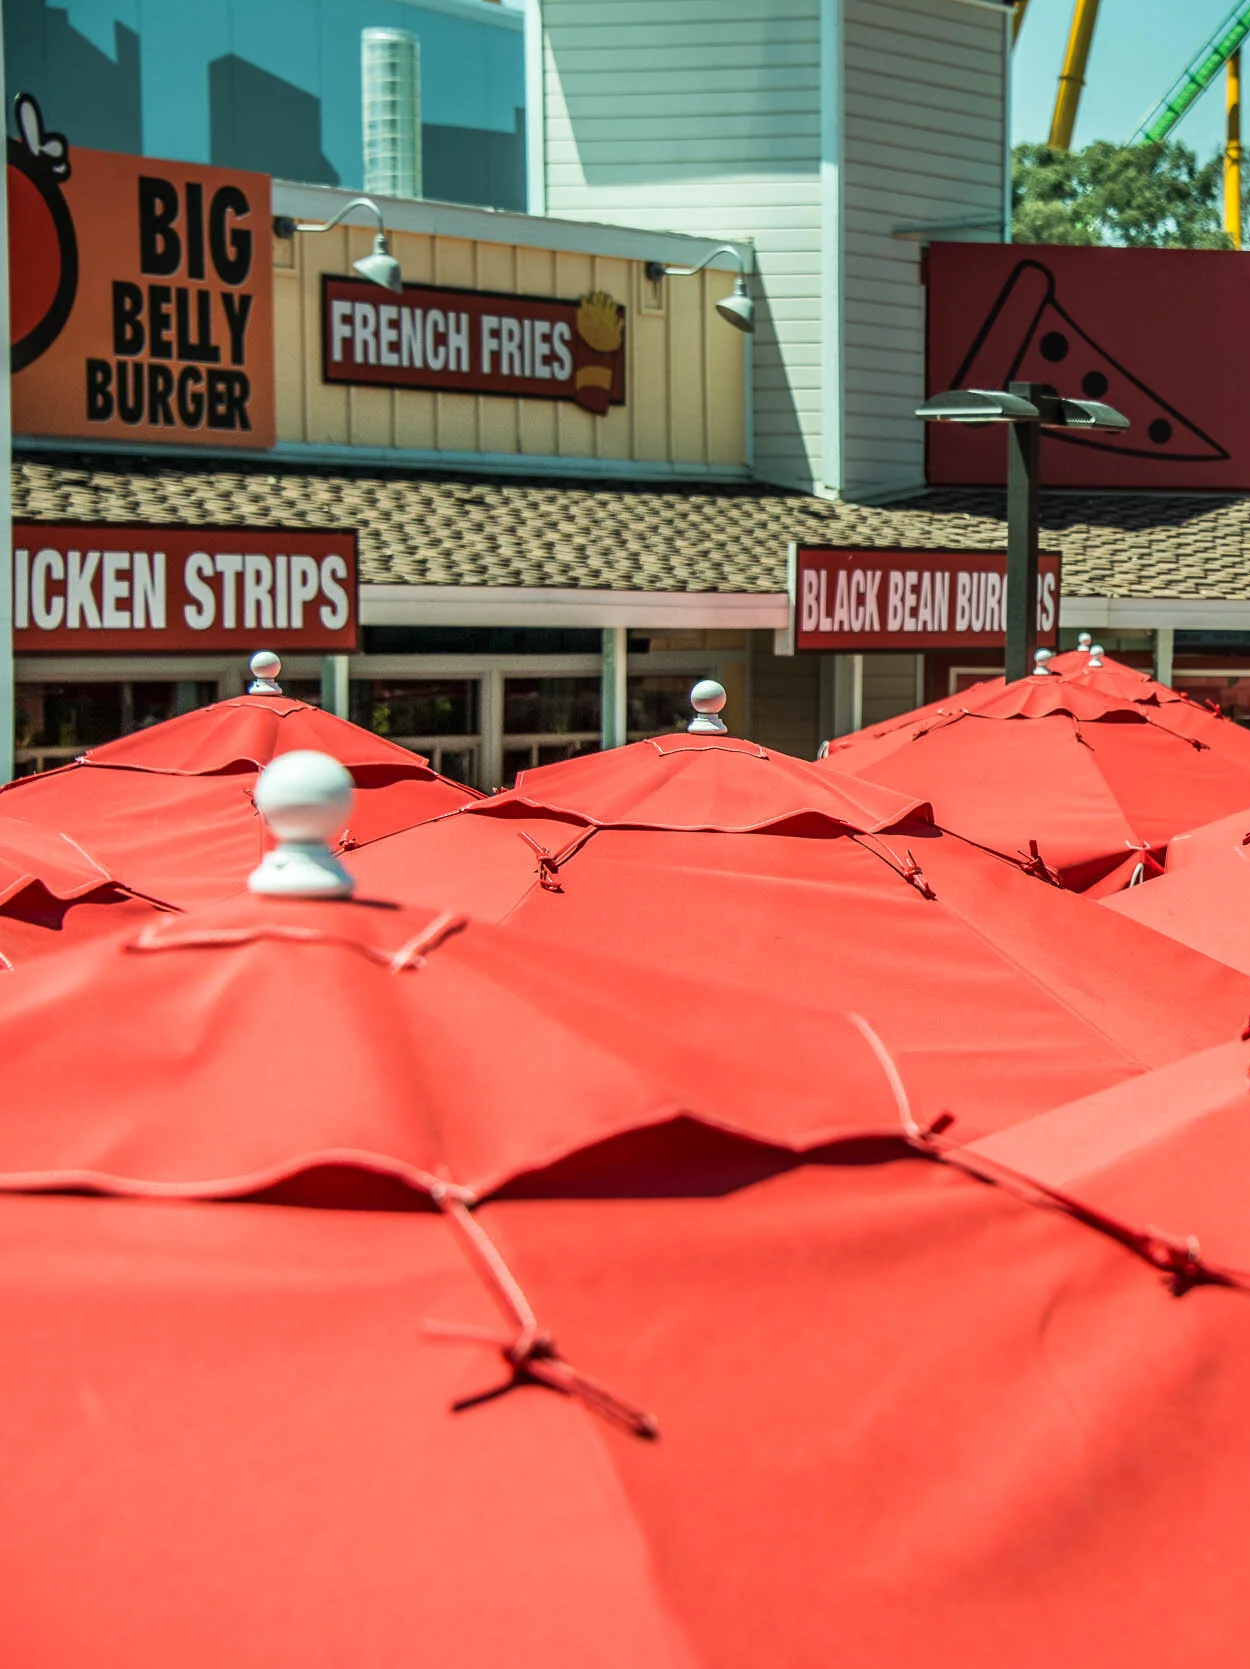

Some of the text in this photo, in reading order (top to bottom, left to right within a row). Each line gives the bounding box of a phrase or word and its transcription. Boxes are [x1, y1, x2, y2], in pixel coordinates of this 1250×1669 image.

[138, 175, 252, 286] BIG
[112, 279, 252, 366] BELLY
[331, 299, 573, 382] FRENCH FRIES
[86, 357, 252, 432] BURGER
[183, 552, 349, 630] STRIPS
[802, 569, 1056, 632] BLACK BEAN BURS
